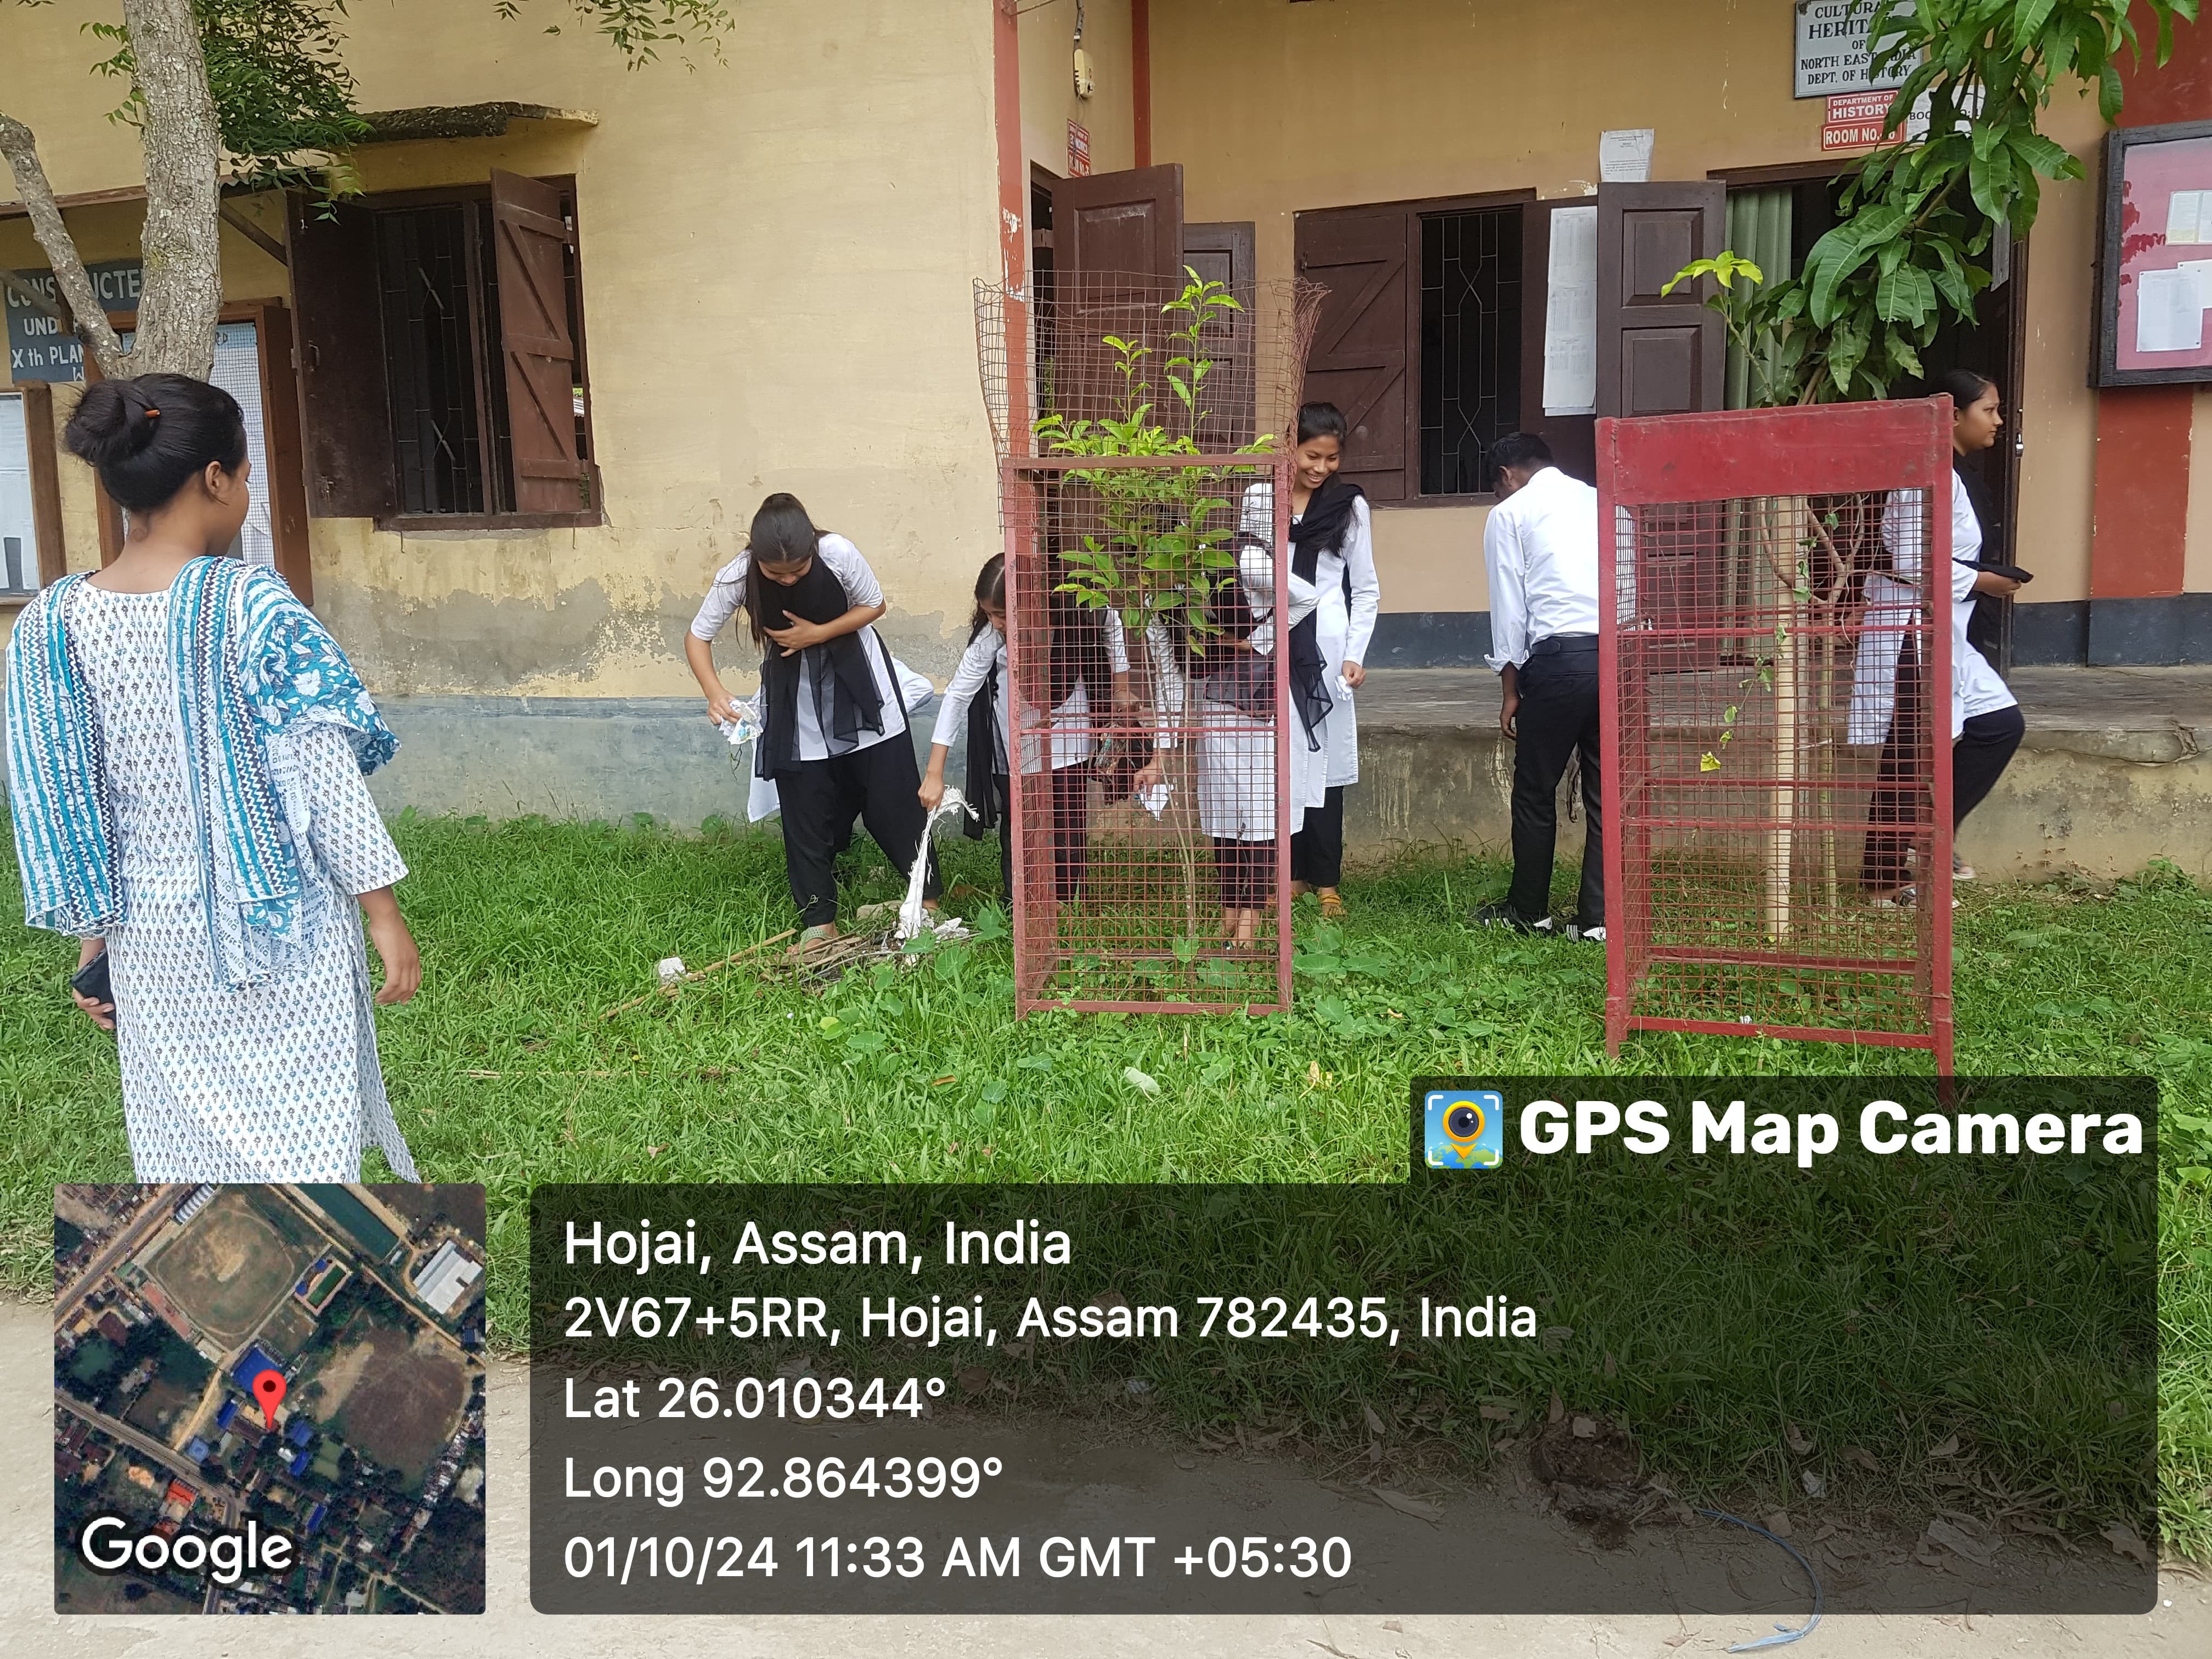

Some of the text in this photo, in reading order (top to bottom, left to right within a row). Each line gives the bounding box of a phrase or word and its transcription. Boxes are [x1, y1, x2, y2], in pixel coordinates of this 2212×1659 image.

[1809, 19, 1871, 39] HERIT
[1852, 40, 1865, 49] OF
[1801, 55, 1839, 70] NORTH
[1844, 52, 1877, 65] EAST
[1808, 65, 1911, 85] DEPT. OF HTORY
[1833, 95, 1882, 106] DEPARTMENT
[1832, 103, 1892, 119] HISTORY
[1826, 128, 1859, 145] ROOM
[12, 348, 25, 369] X
[28, 348, 43, 366] th
